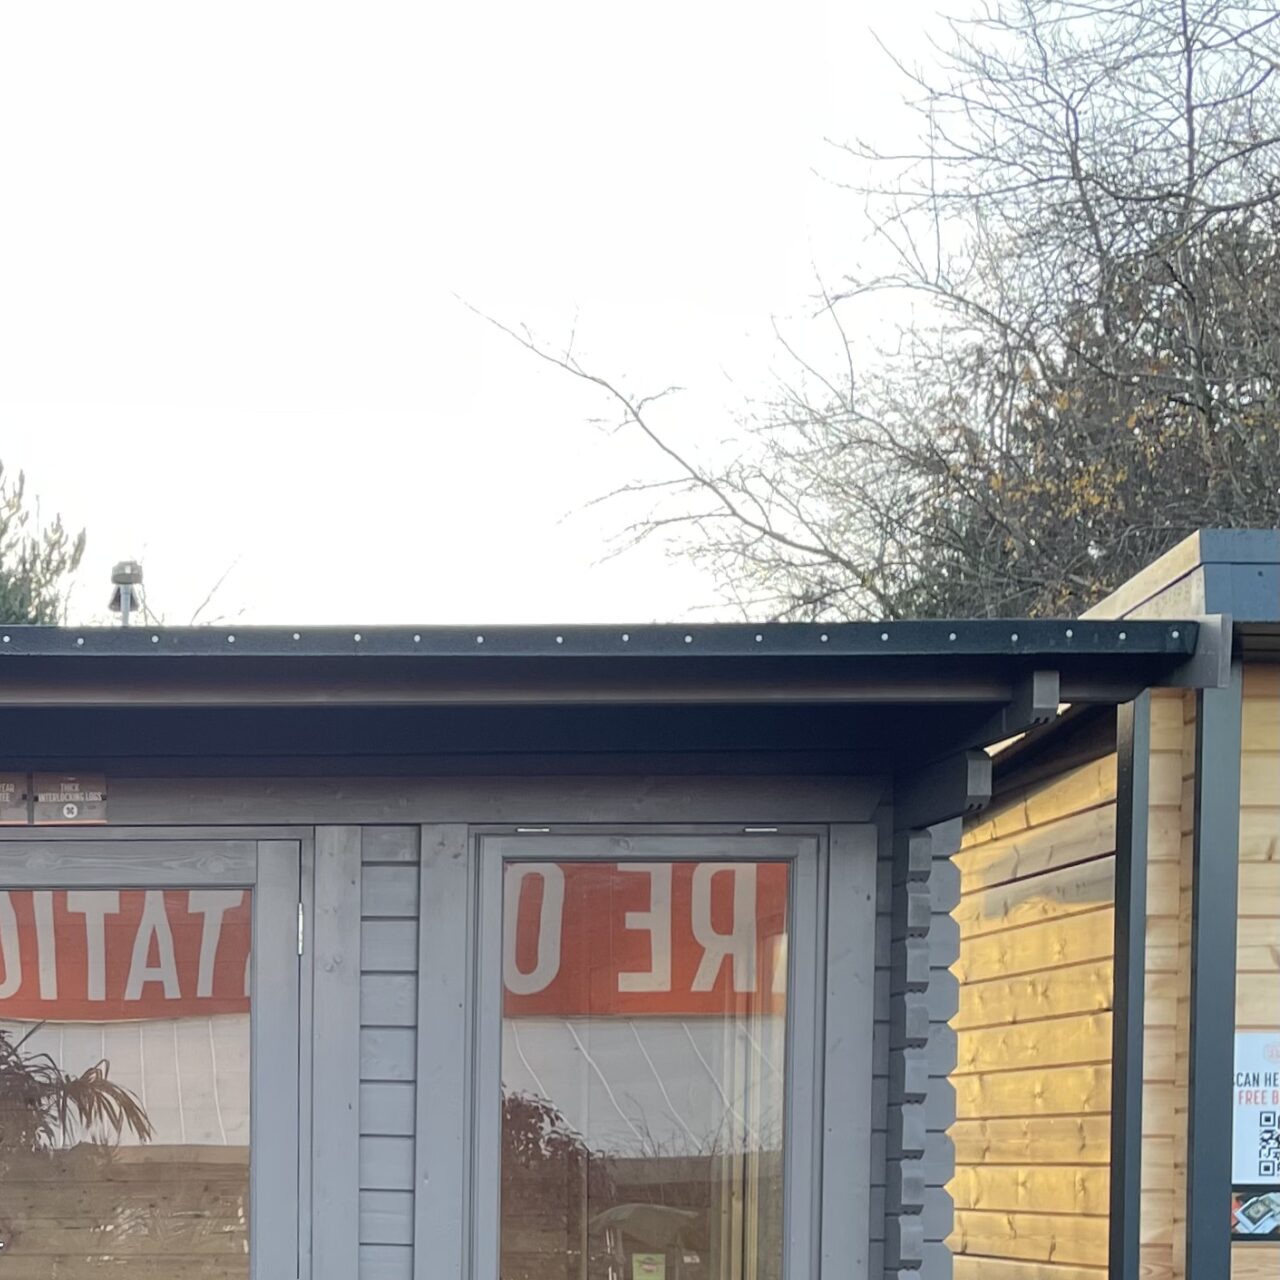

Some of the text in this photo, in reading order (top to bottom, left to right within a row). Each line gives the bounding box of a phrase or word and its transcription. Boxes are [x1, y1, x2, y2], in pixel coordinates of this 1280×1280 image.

[60, 783, 80, 792] THICK
[38, 792, 103, 802] INTERLOCKING LOGS
[1238, 1089, 1267, 1105] FREE
